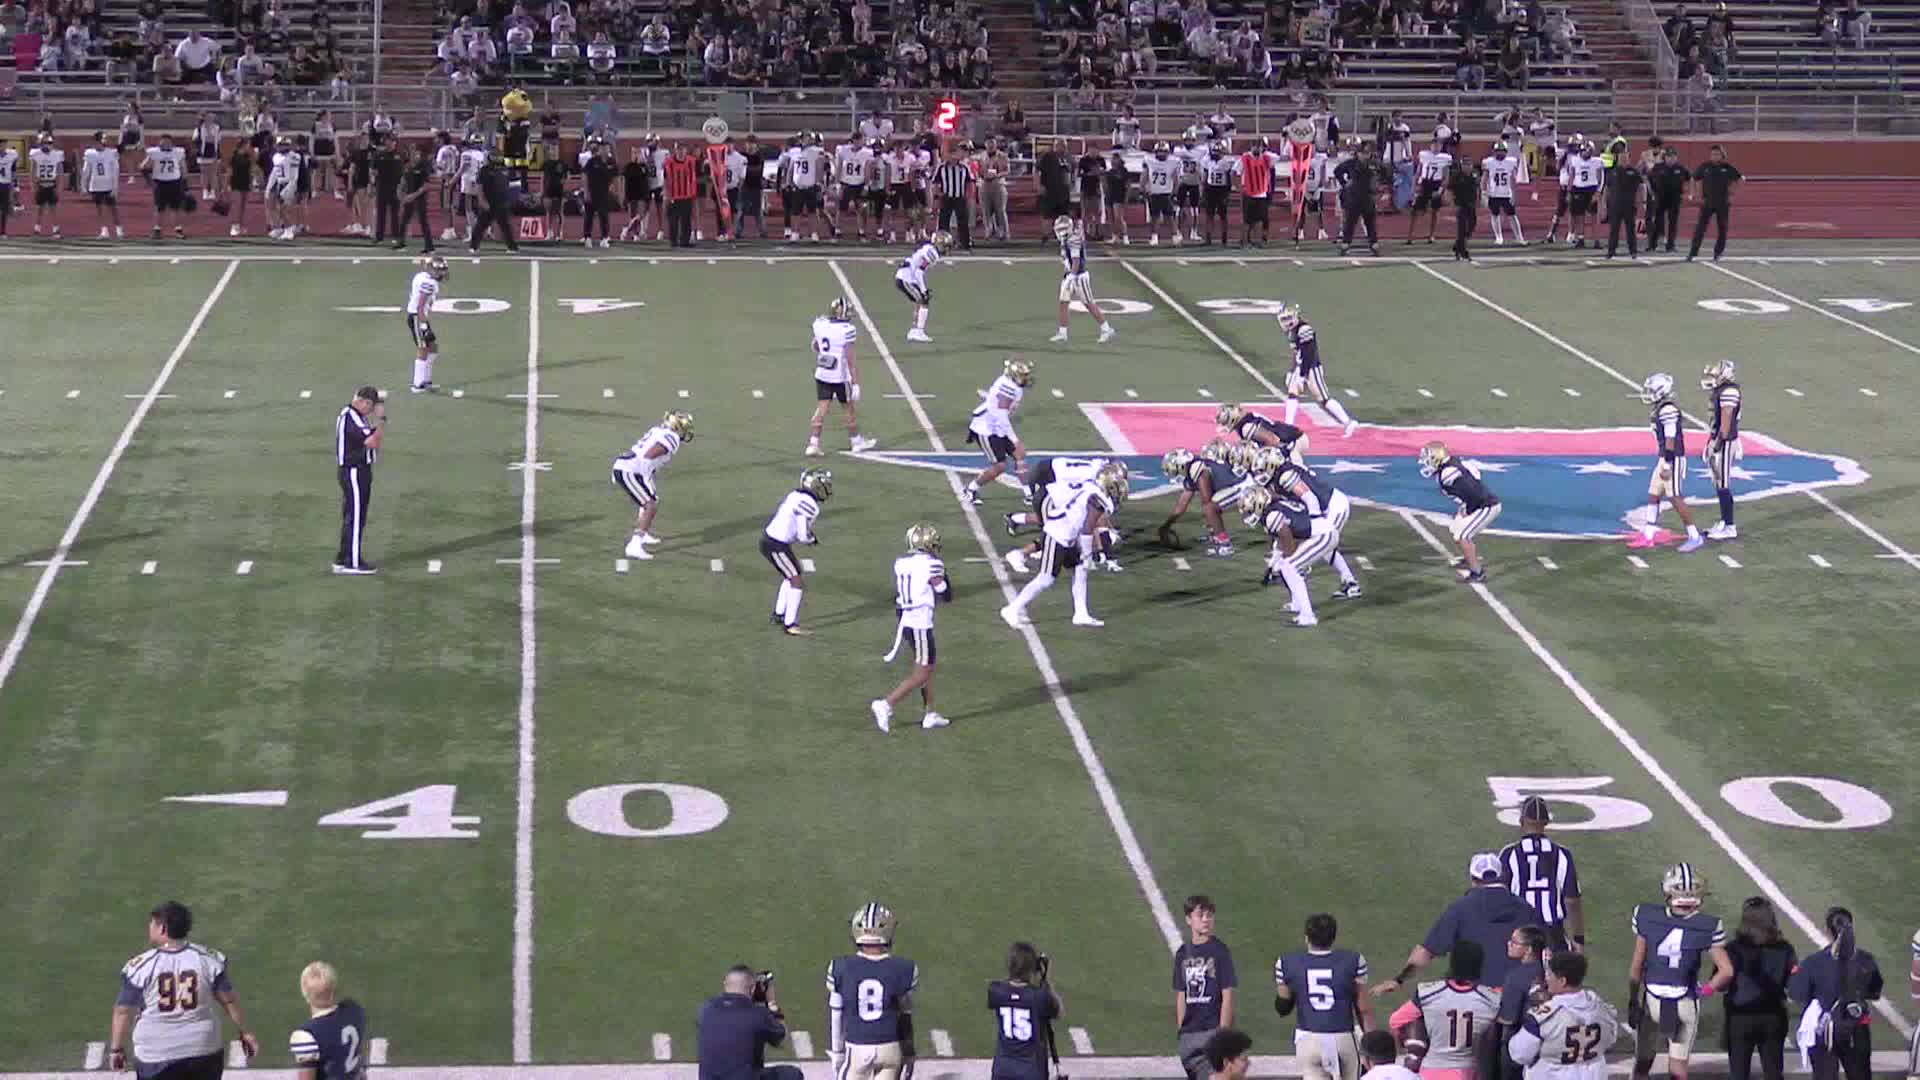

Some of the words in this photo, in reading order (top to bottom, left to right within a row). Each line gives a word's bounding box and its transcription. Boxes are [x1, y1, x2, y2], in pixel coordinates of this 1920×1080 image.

[937, 102, 957, 130] 2
[160, 160, 174, 173] 72
[1152, 171, 1167, 186] 73
[1493, 172, 1507, 186] 45
[522, 219, 538, 236] 40
[1527, 854, 1549, 889] L
[1657, 926, 1684, 969] 4
[158, 968, 198, 1013] 93
[858, 978, 884, 1021] 8
[1307, 968, 1335, 1011] 5
[999, 1006, 1033, 1041] 15
[1446, 1009, 1474, 1049] 11
[341, 1024, 360, 1073] 2
[1560, 1022, 1602, 1065] 52
